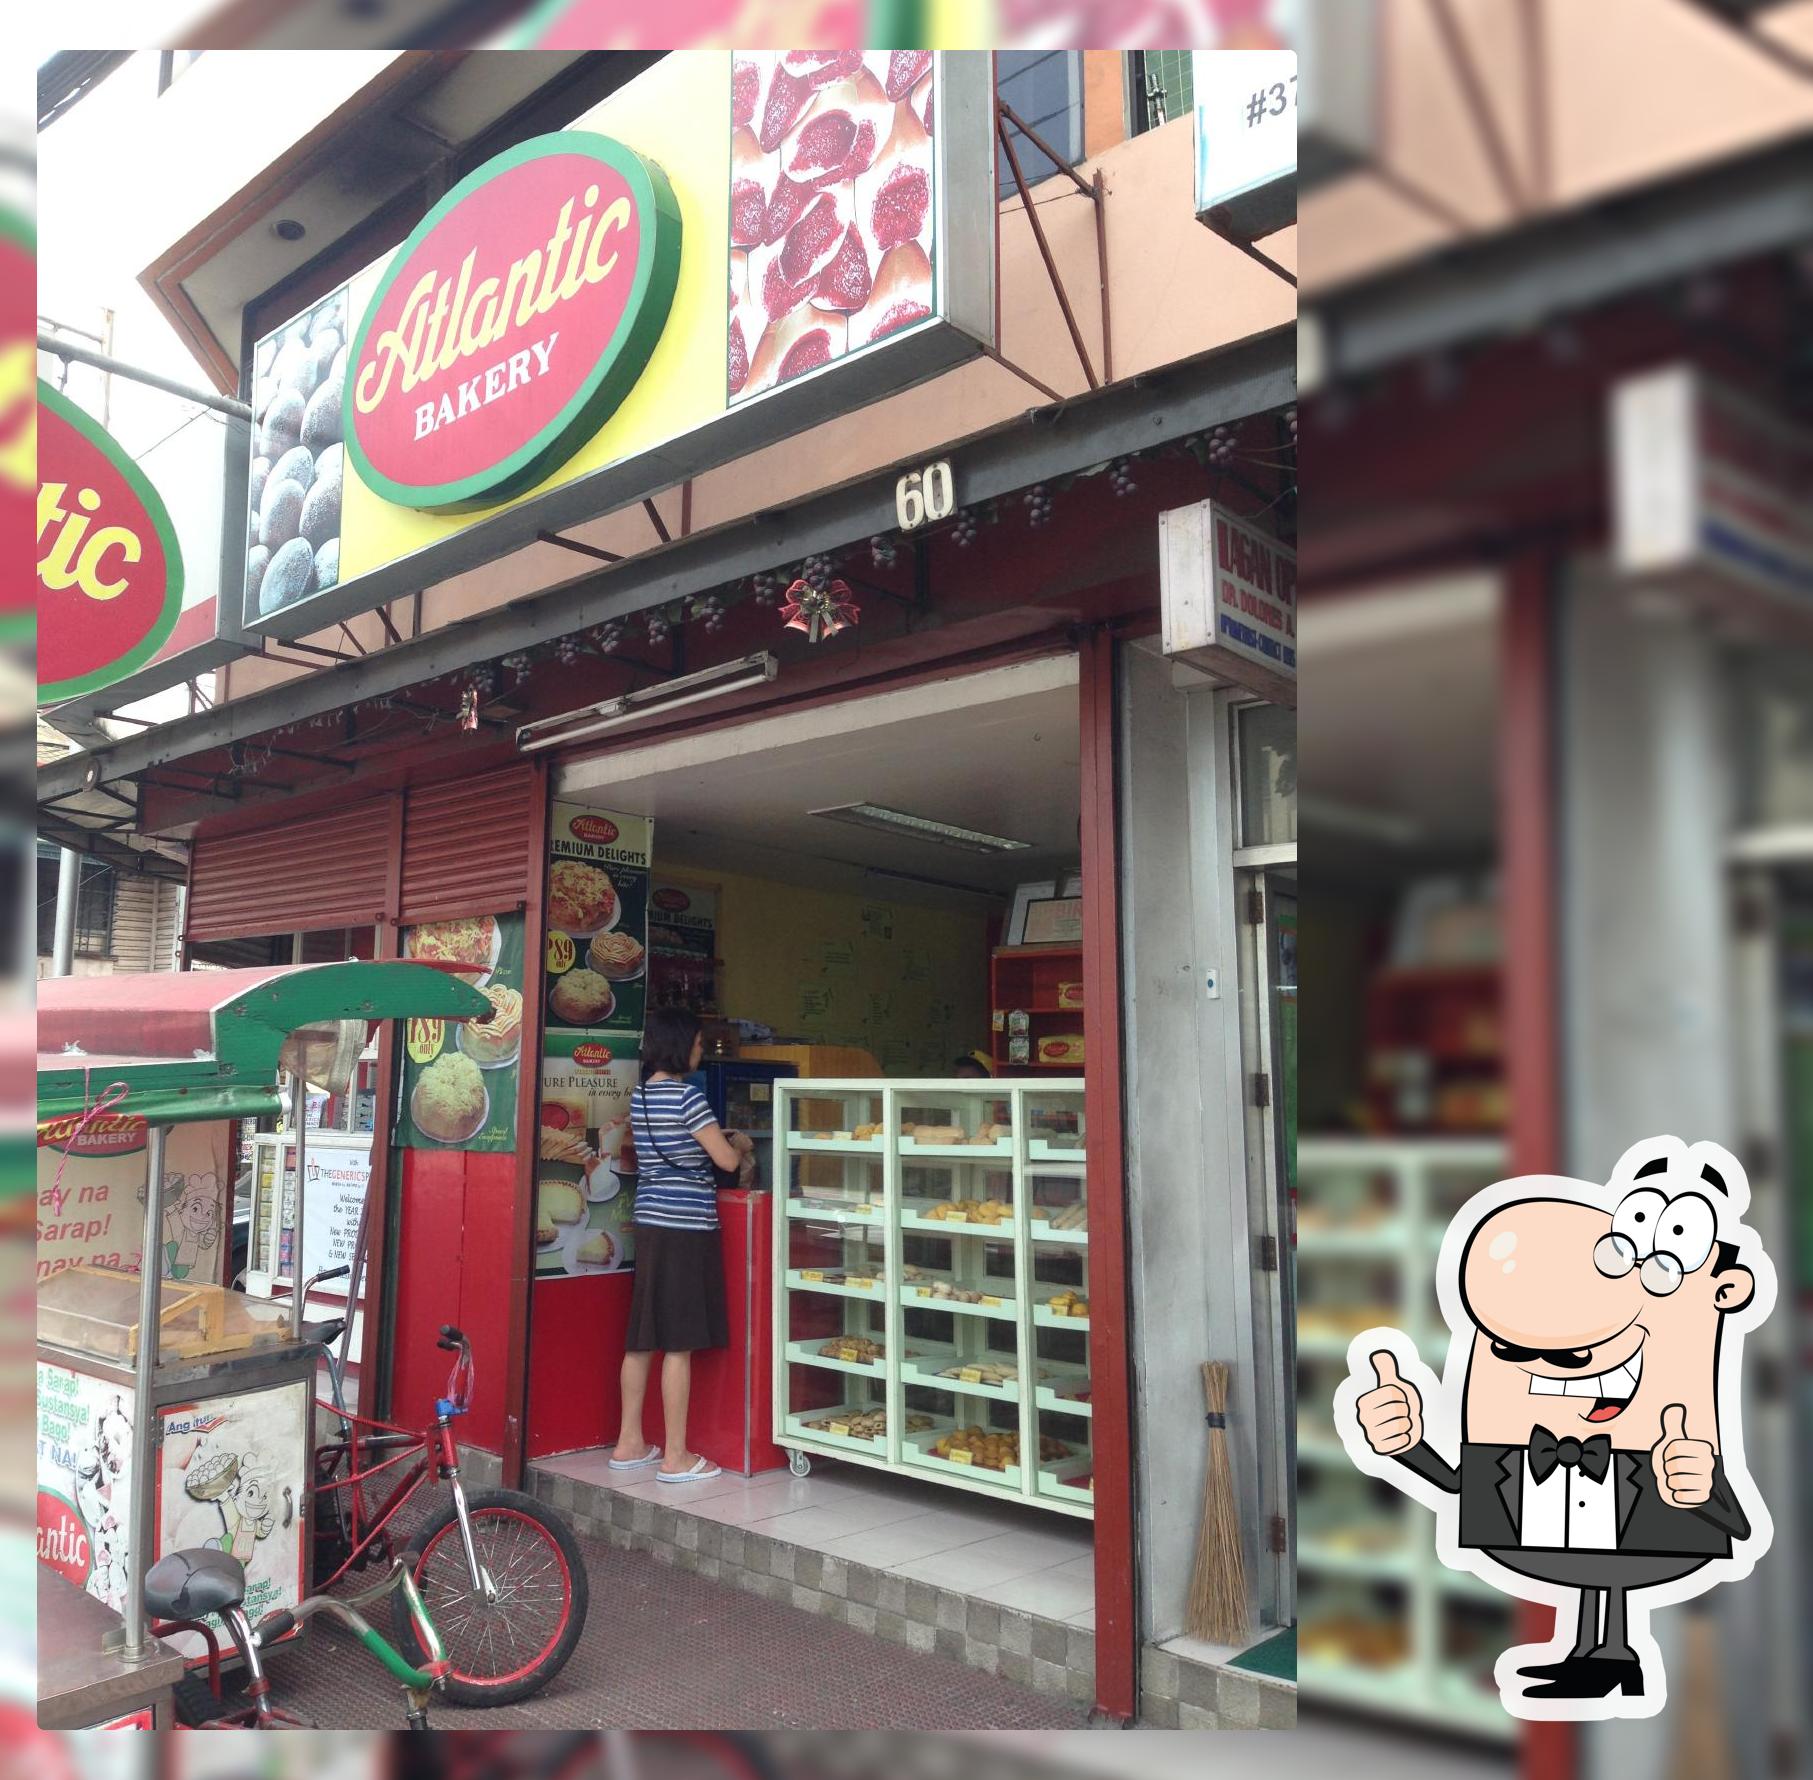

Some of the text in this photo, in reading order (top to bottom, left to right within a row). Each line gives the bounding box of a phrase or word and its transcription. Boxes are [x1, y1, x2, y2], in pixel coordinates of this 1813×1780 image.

[355, 183, 631, 415] Atlantic
[413, 332, 560, 443] BAKERY
[896, 462, 953, 531] 60
[571, 817, 619, 837] Atlantic
[597, 845, 647, 866] DELIGHTS
[573, 1045, 613, 1060] Atlantic
[567, 1075, 619, 1089] PLEASURE
[77, 1132, 137, 1147] BAKERY
[78, 1184, 110, 1204] na
[47, 1367, 79, 1398] Sarap!
[168, 1421, 191, 1434] Ang
[51, 1445, 77, 1469] NA!
[245, 1577, 271, 1593] arap!
